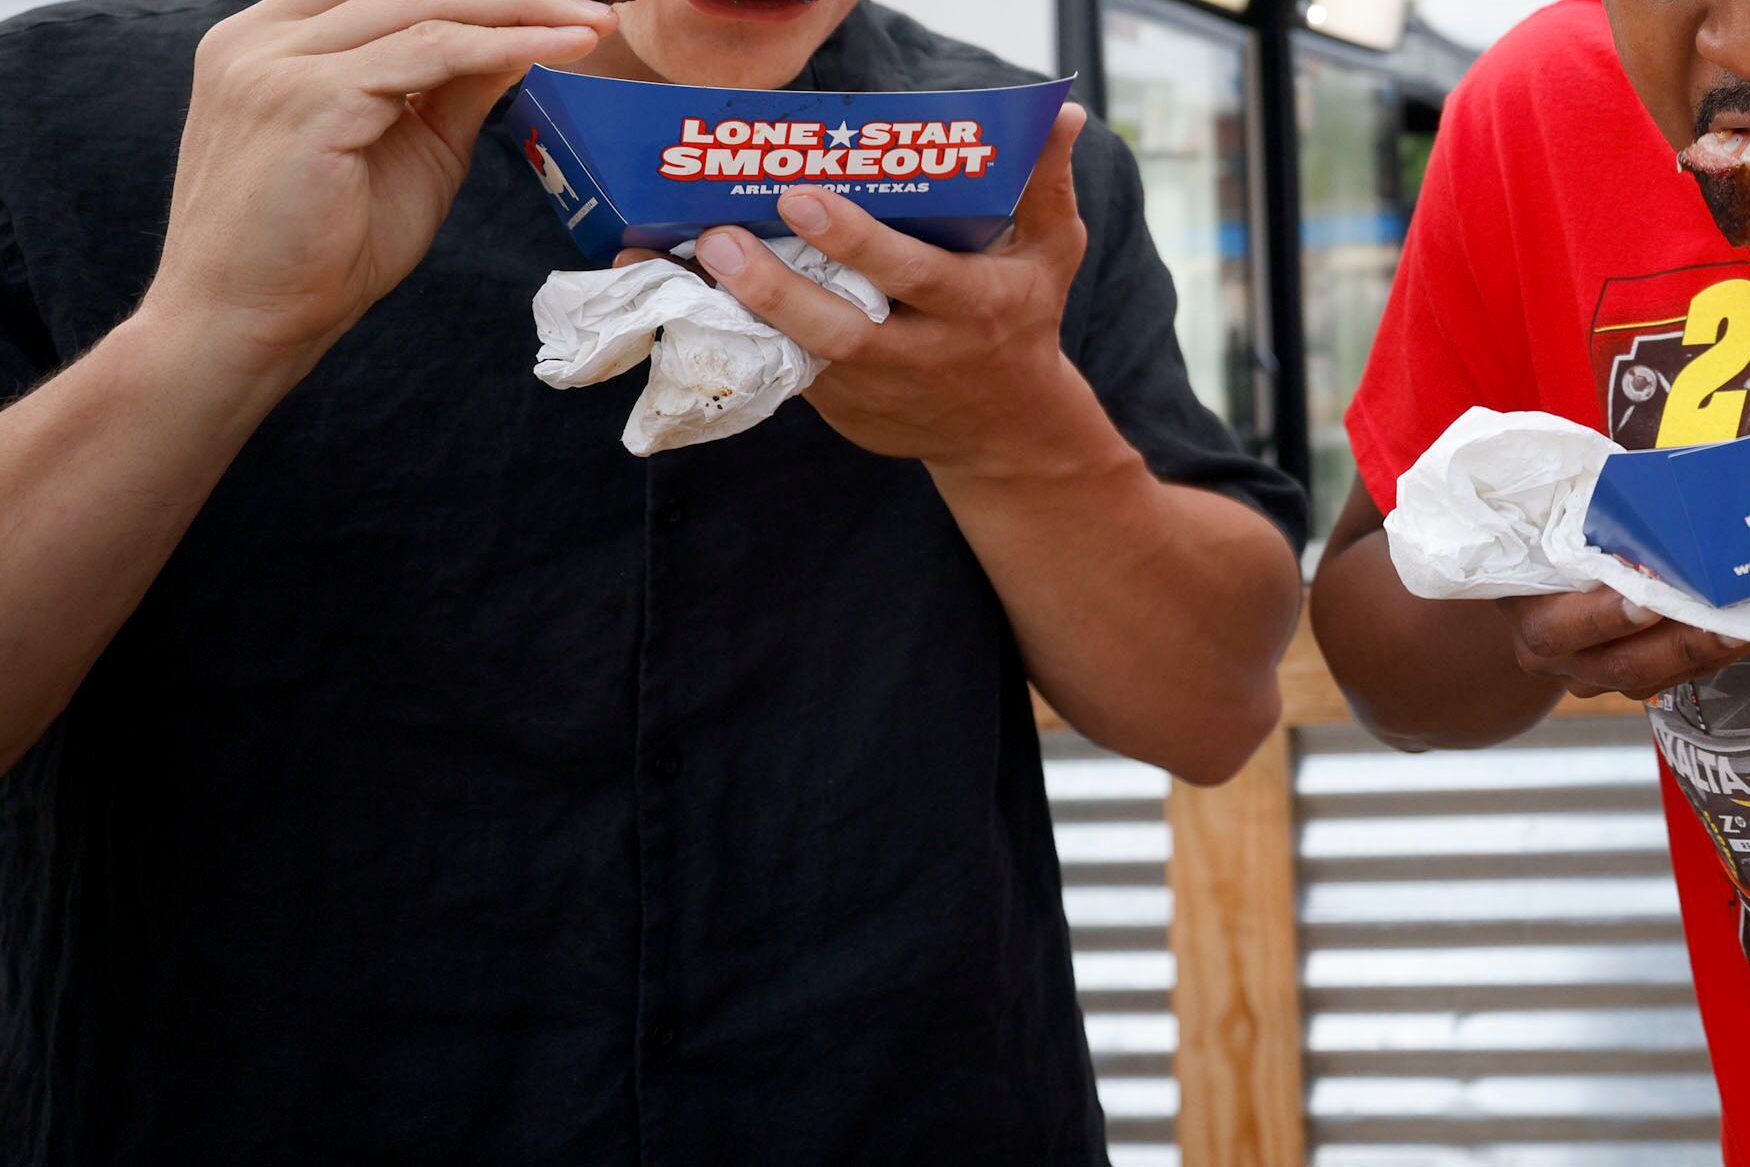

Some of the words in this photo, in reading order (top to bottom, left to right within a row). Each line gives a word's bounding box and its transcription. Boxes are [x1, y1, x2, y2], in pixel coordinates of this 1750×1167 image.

[681, 118, 822, 146] LONE
[858, 120, 979, 146] STAR
[660, 145, 993, 177] SMOKEOUT
[730, 182, 850, 195] ARLINON
[866, 182, 930, 194] TEXAS
